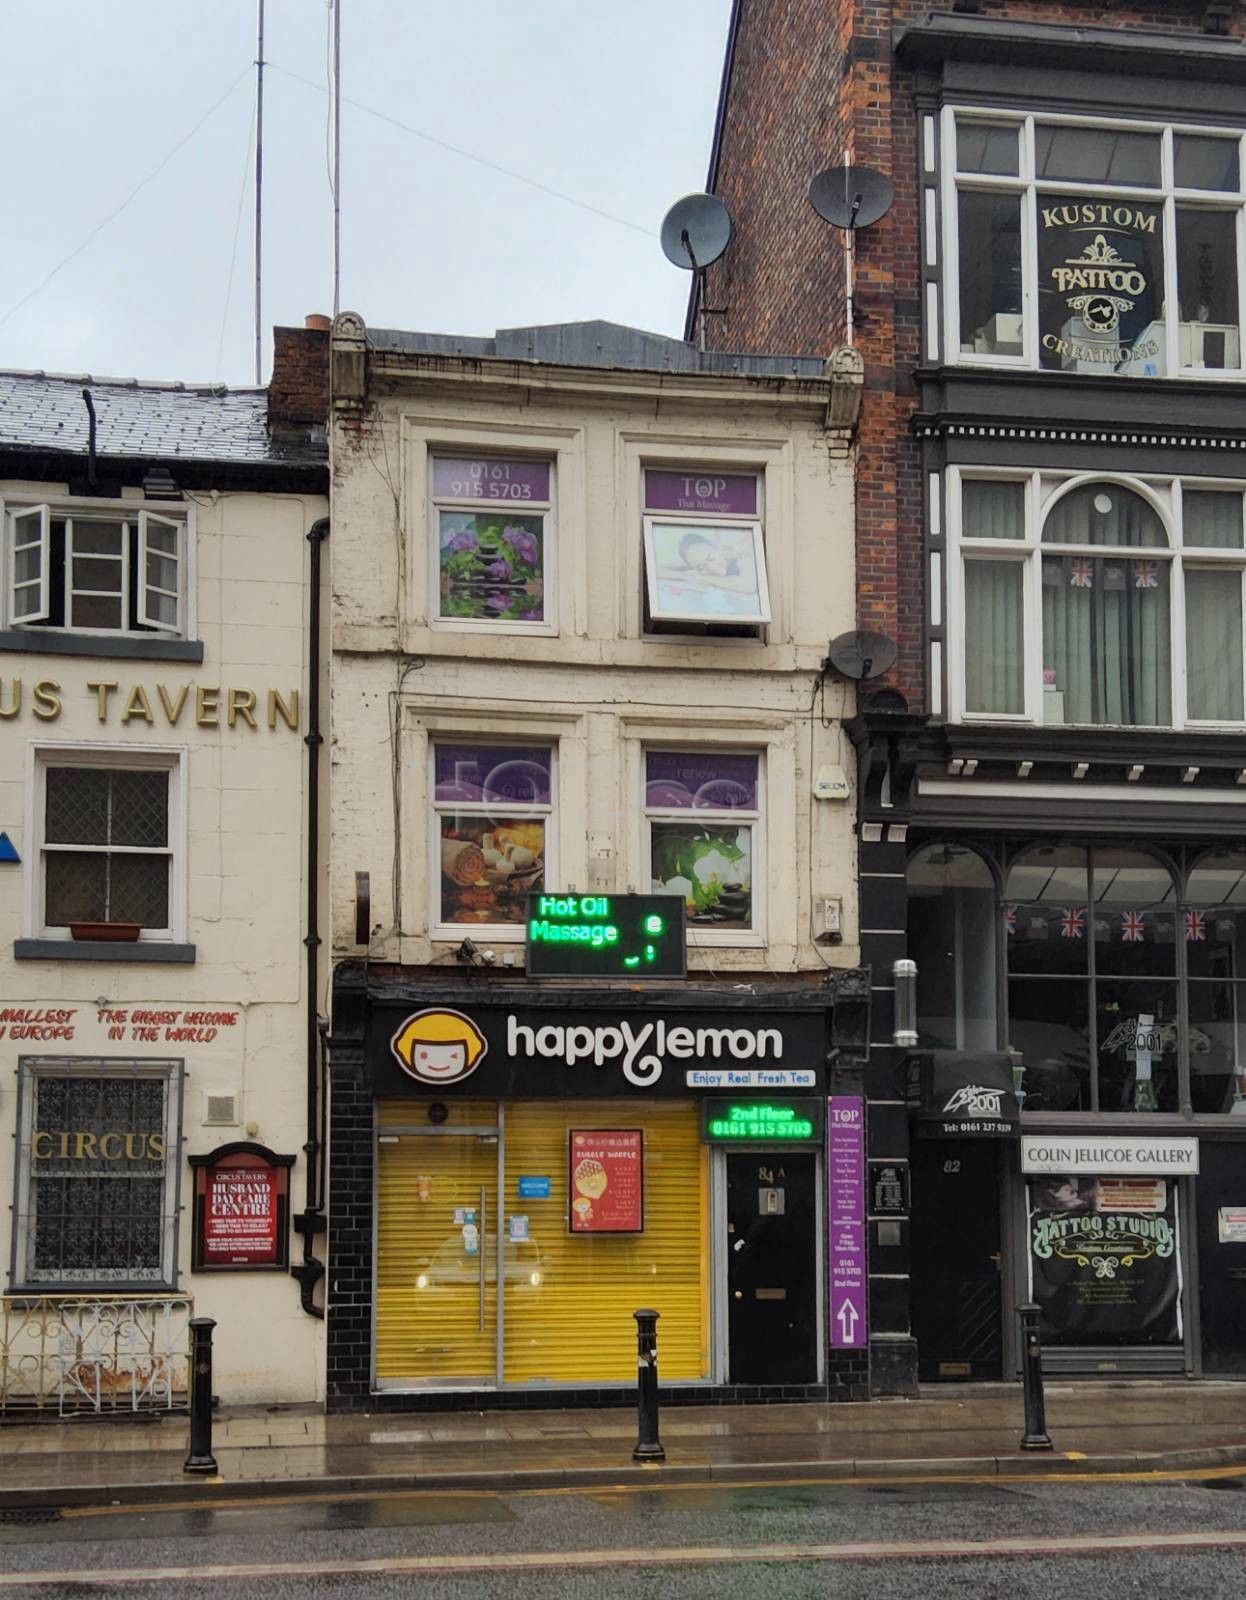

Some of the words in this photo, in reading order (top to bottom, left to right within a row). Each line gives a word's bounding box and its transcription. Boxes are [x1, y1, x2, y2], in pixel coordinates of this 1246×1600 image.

[1042, 205, 1157, 233] KUSTOM
[1052, 268, 1147, 295] TATTOO
[1042, 334, 1159, 363] CREATIONS
[470, 462, 510, 479] 0161
[451, 481, 484, 496] 915
[489, 483, 532, 499] 5703
[681, 478, 726, 498] TOP
[87, 679, 300, 731] TAVERN
[819, 783, 846, 791] SECOM
[540, 897, 577, 915] Hot
[581, 898, 608, 915] Oil
[530, 921, 617, 945] Massage
[97, 1009, 128, 1024] THE
[131, 1010, 182, 1025] BIGGEST
[183, 1012, 239, 1026] WELCOME
[9, 1025, 75, 1041] EUROPE
[108, 1026, 126, 1040] IN
[132, 1027, 160, 1041] THE
[165, 1027, 218, 1043] WORLD
[1127, 1033, 1162, 1053] 2001
[693, 1072, 722, 1085] Enjoy
[728, 1072, 752, 1083] Real
[757, 1072, 786, 1084] Fresh
[790, 1072, 811, 1083] Tea
[968, 1095, 1001, 1112] 2001
[730, 1107, 758, 1120] 2nd
[760, 1107, 795, 1121] Floor
[832, 1109, 859, 1122] TOP
[711, 1121, 746, 1135] 0161
[749, 1121, 776, 1136] 915
[777, 1121, 812, 1136] 5703
[943, 1123, 959, 1133] Tel:
[960, 1122, 981, 1132] 0161
[983, 1122, 996, 1132] 237
[31, 1130, 166, 1161] CIRCUS
[1027, 1148, 1072, 1162] COLIN
[1074, 1149, 1132, 1164] JELLICOE
[1135, 1149, 1193, 1163] GALLERY
[943, 1159, 961, 1173] 82
[758, 1166, 774, 1184] 84
[212, 1183, 271, 1194] HUSBAND
[212, 1194, 234, 1205] DAY
[237, 1194, 271, 1205] CARE
[211, 1203, 271, 1216] CENTRE
[1034, 1216, 1101, 1252] TATTOO
[1107, 1216, 1173, 1250] STUDIO
[839, 1259, 855, 1267] 0161
